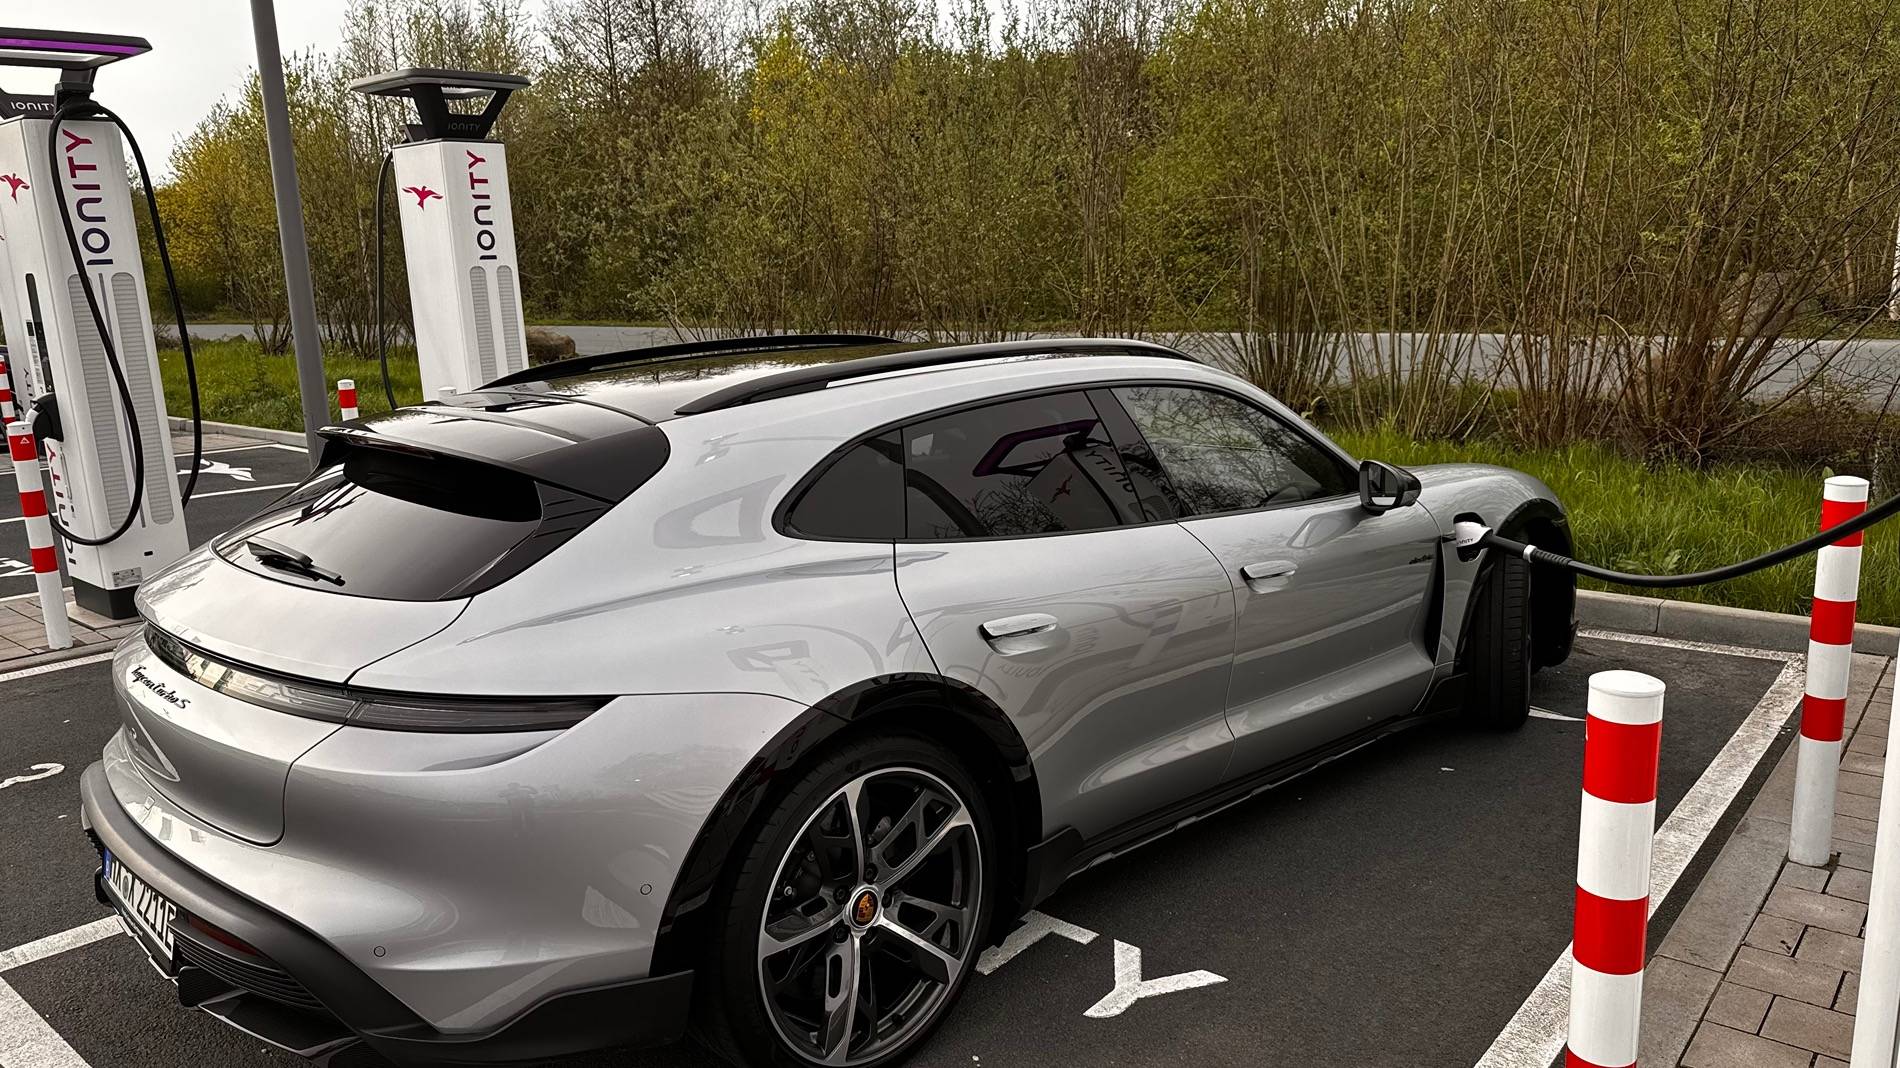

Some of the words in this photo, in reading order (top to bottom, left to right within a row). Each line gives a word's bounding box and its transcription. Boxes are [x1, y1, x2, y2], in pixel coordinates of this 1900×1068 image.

[448, 121, 481, 132] IONITY
[62, 128, 114, 266] IONITY
[466, 150, 498, 261] IONITY
